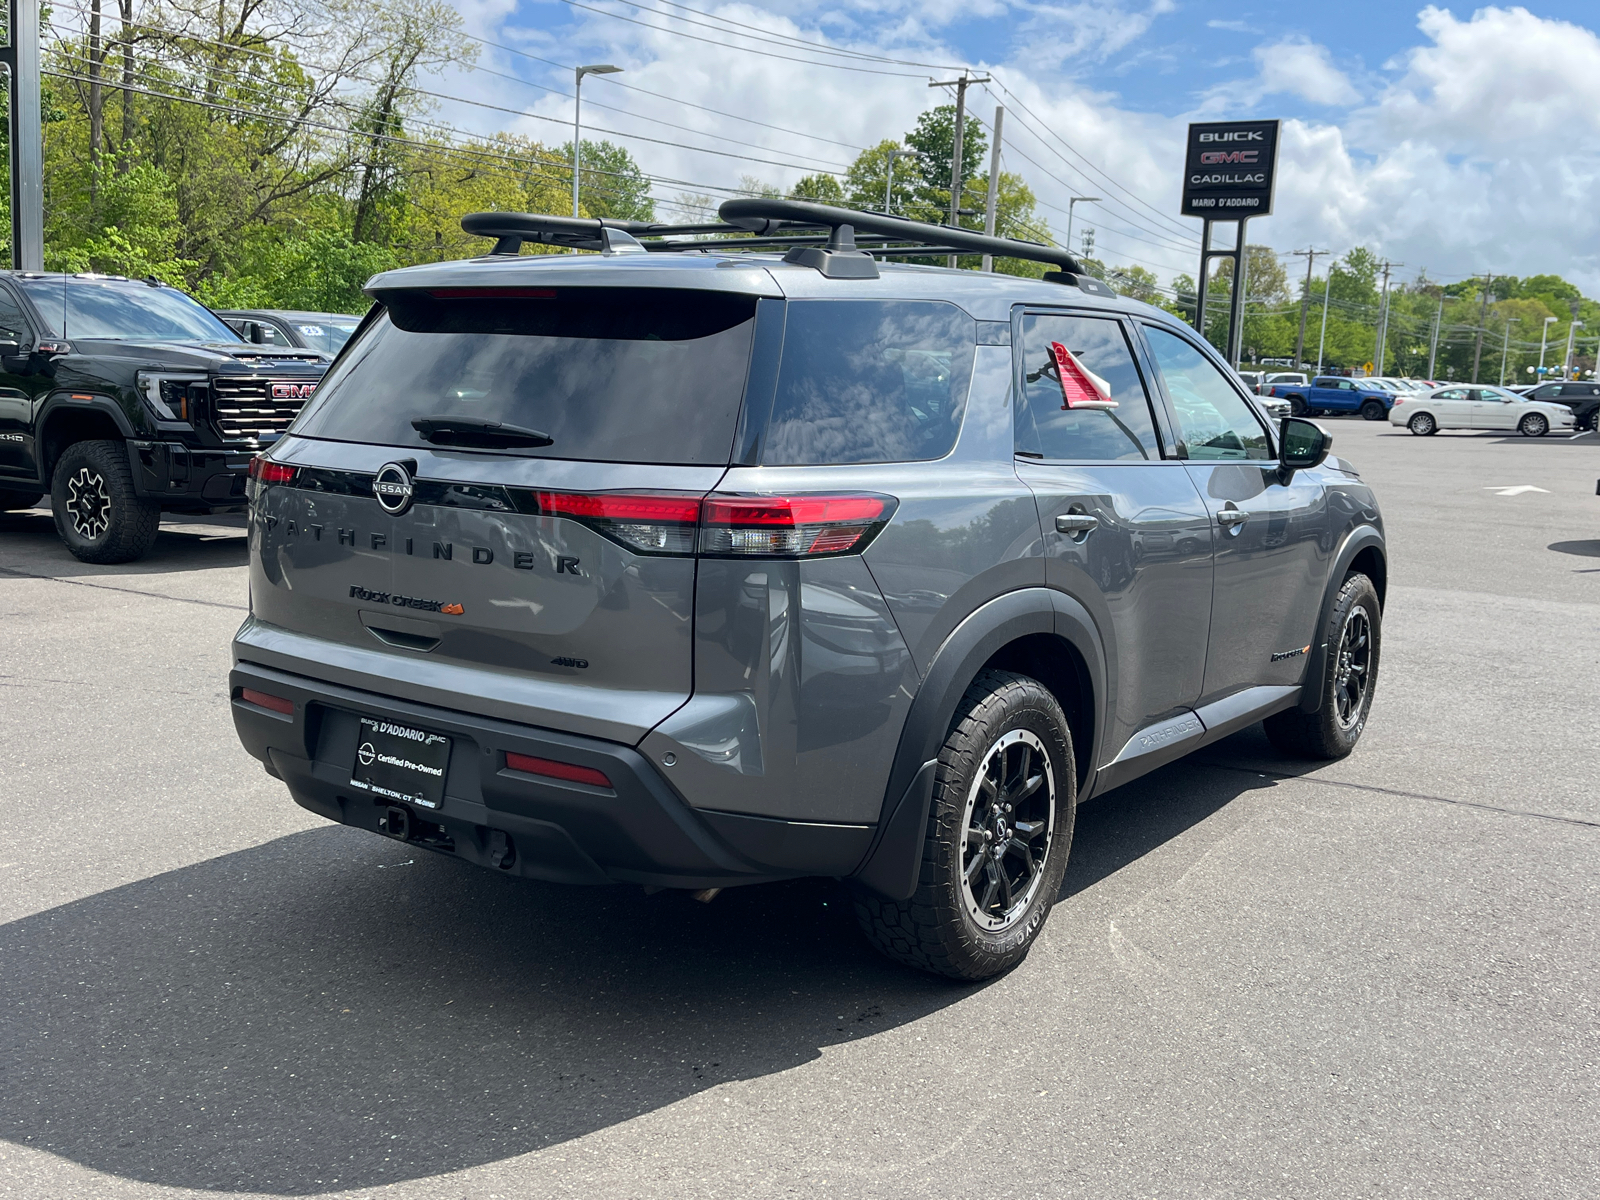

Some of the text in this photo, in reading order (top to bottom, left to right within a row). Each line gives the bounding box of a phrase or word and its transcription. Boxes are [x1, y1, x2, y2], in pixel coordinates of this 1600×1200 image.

[1199, 131, 1263, 142] BUICK
[1201, 151, 1259, 164] GMC
[1191, 173, 1265, 184] CADILLAC
[1191, 198, 1259, 207] MARIO D'ADDARIO
[372, 483, 411, 495] NISSAN
[264, 514, 582, 576] PATHFINDER
[550, 656, 589, 668] 4WD
[380, 723, 425, 741] D'ADDARIO
[1139, 718, 1200, 748] PATHFINDER
[377, 754, 443, 776] Certified Pre-Owned
[371, 787, 401, 799] SHELTON,
